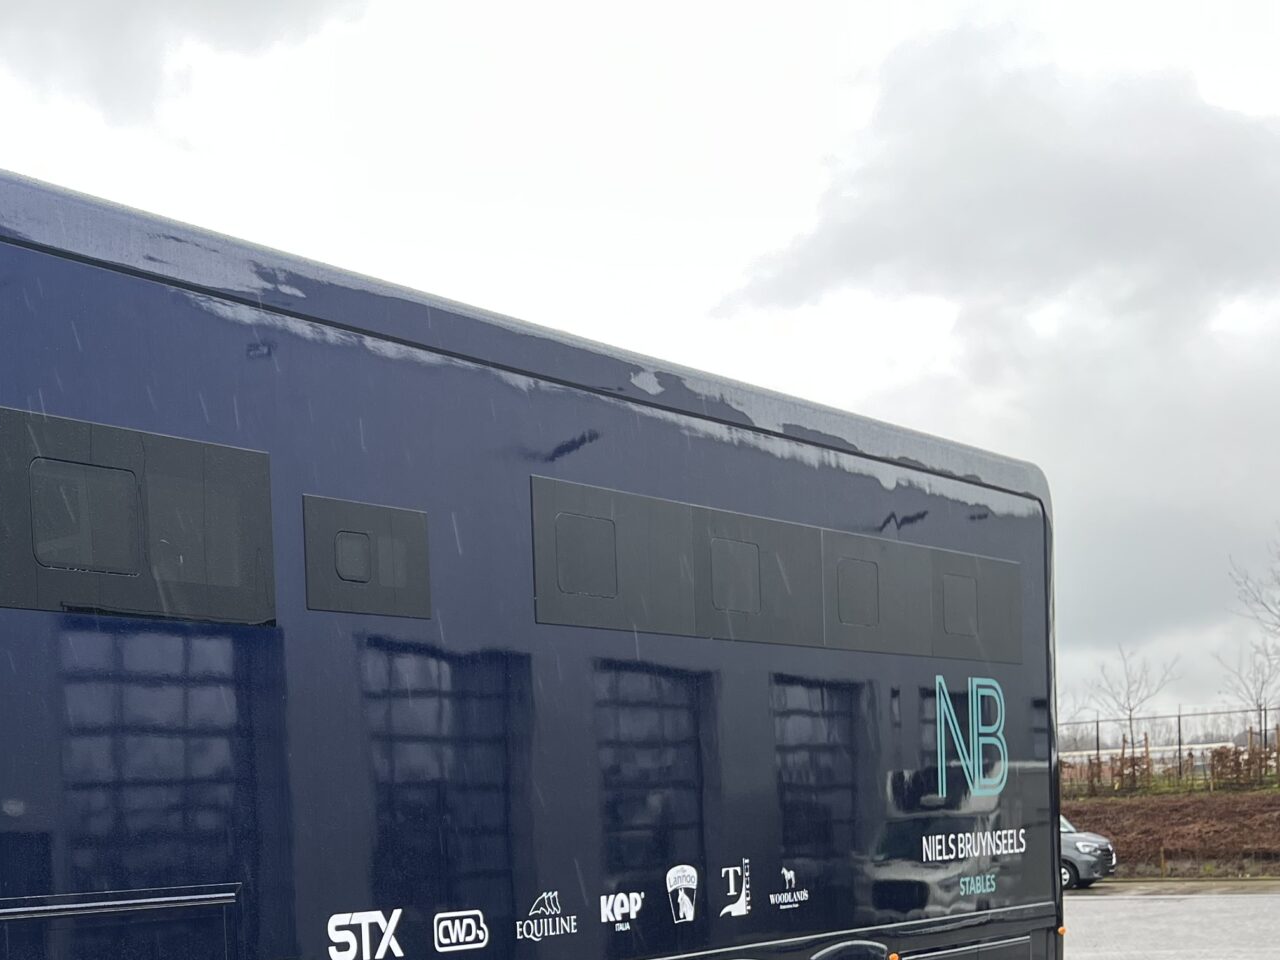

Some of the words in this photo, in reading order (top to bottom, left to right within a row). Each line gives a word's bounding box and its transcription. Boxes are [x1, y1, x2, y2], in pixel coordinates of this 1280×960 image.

[935, 675, 1008, 798] NB
[922, 833, 956, 862] NIELS
[958, 829, 1026, 858] BRUYNSEELS
[960, 874, 996, 896] STABLES
[516, 915, 577, 941] EQUILINE
[615, 922, 630, 931] ITALIA
